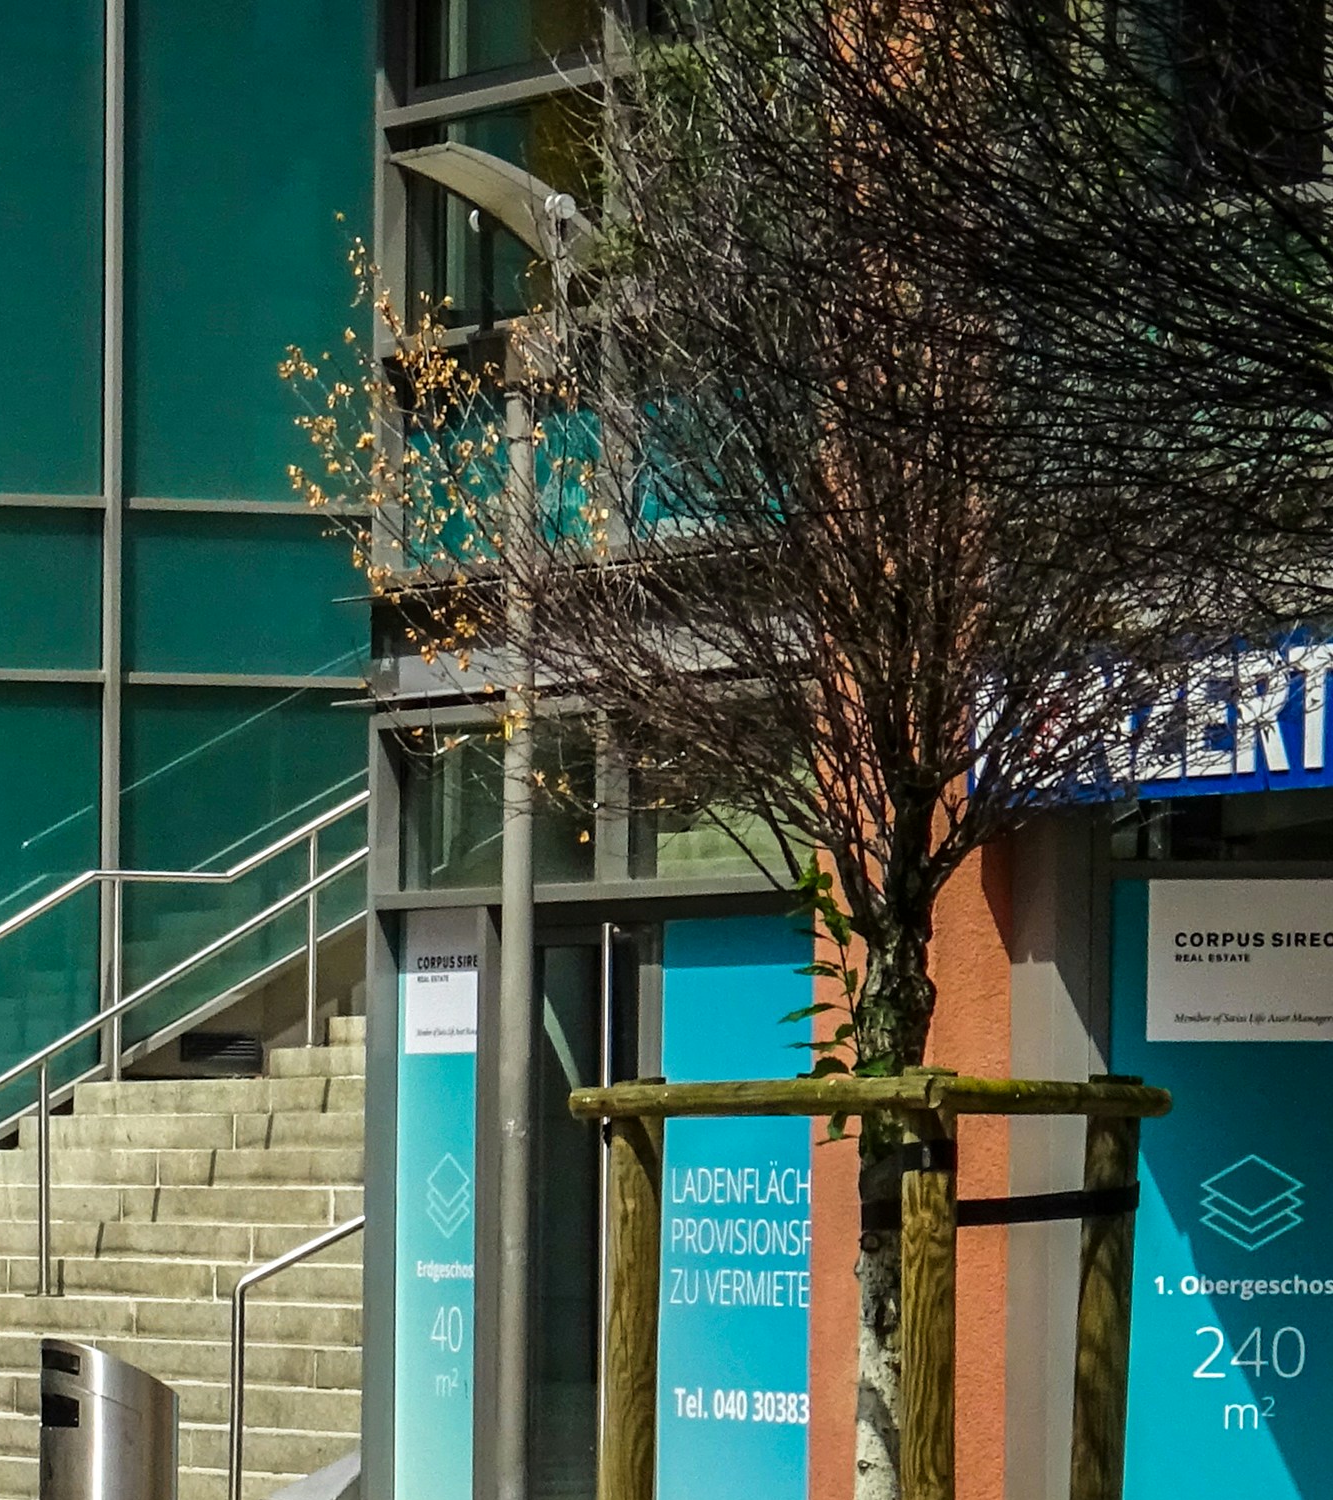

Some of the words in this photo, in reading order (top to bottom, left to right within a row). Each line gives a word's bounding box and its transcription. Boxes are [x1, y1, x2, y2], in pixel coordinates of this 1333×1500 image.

[1174, 932, 1265, 948] CORPUS
[417, 956, 455, 970] CORPUS
[1175, 953, 1204, 963] REAL
[1208, 953, 1251, 963] ESTATE
[672, 1161, 812, 1204] LADENFLÄCH
[669, 1269, 700, 1304] ZU
[704, 1269, 811, 1308] VERMIETE
[1154, 1275, 1174, 1295] 1.
[1180, 1274, 1333, 1301] Obergeschos
[430, 1306, 463, 1352] 40
[1193, 1326, 1306, 1378] 240
[674, 1387, 708, 1419] Tel.
[713, 1388, 748, 1421] 040
[752, 1390, 810, 1424] 30383
[1224, 1396, 1276, 1430] m²
